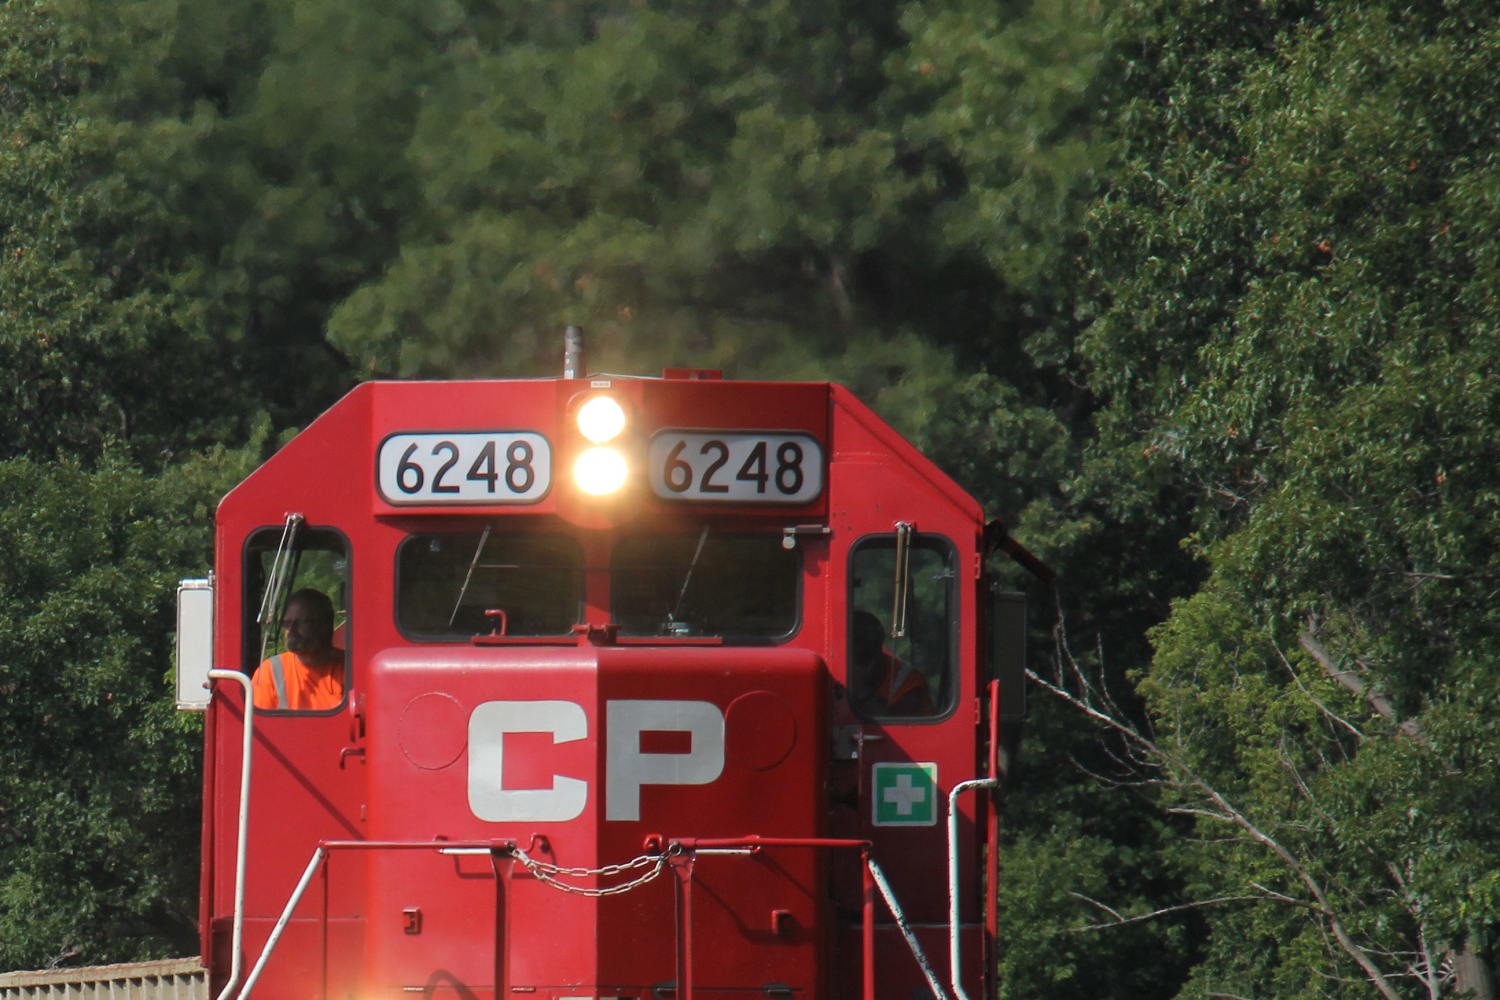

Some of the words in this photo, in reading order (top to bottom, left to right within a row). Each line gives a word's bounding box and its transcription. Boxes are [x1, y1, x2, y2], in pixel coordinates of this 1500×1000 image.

[396, 440, 535, 494] 6248
[663, 440, 804, 495] 6248
[467, 700, 725, 822] CP
